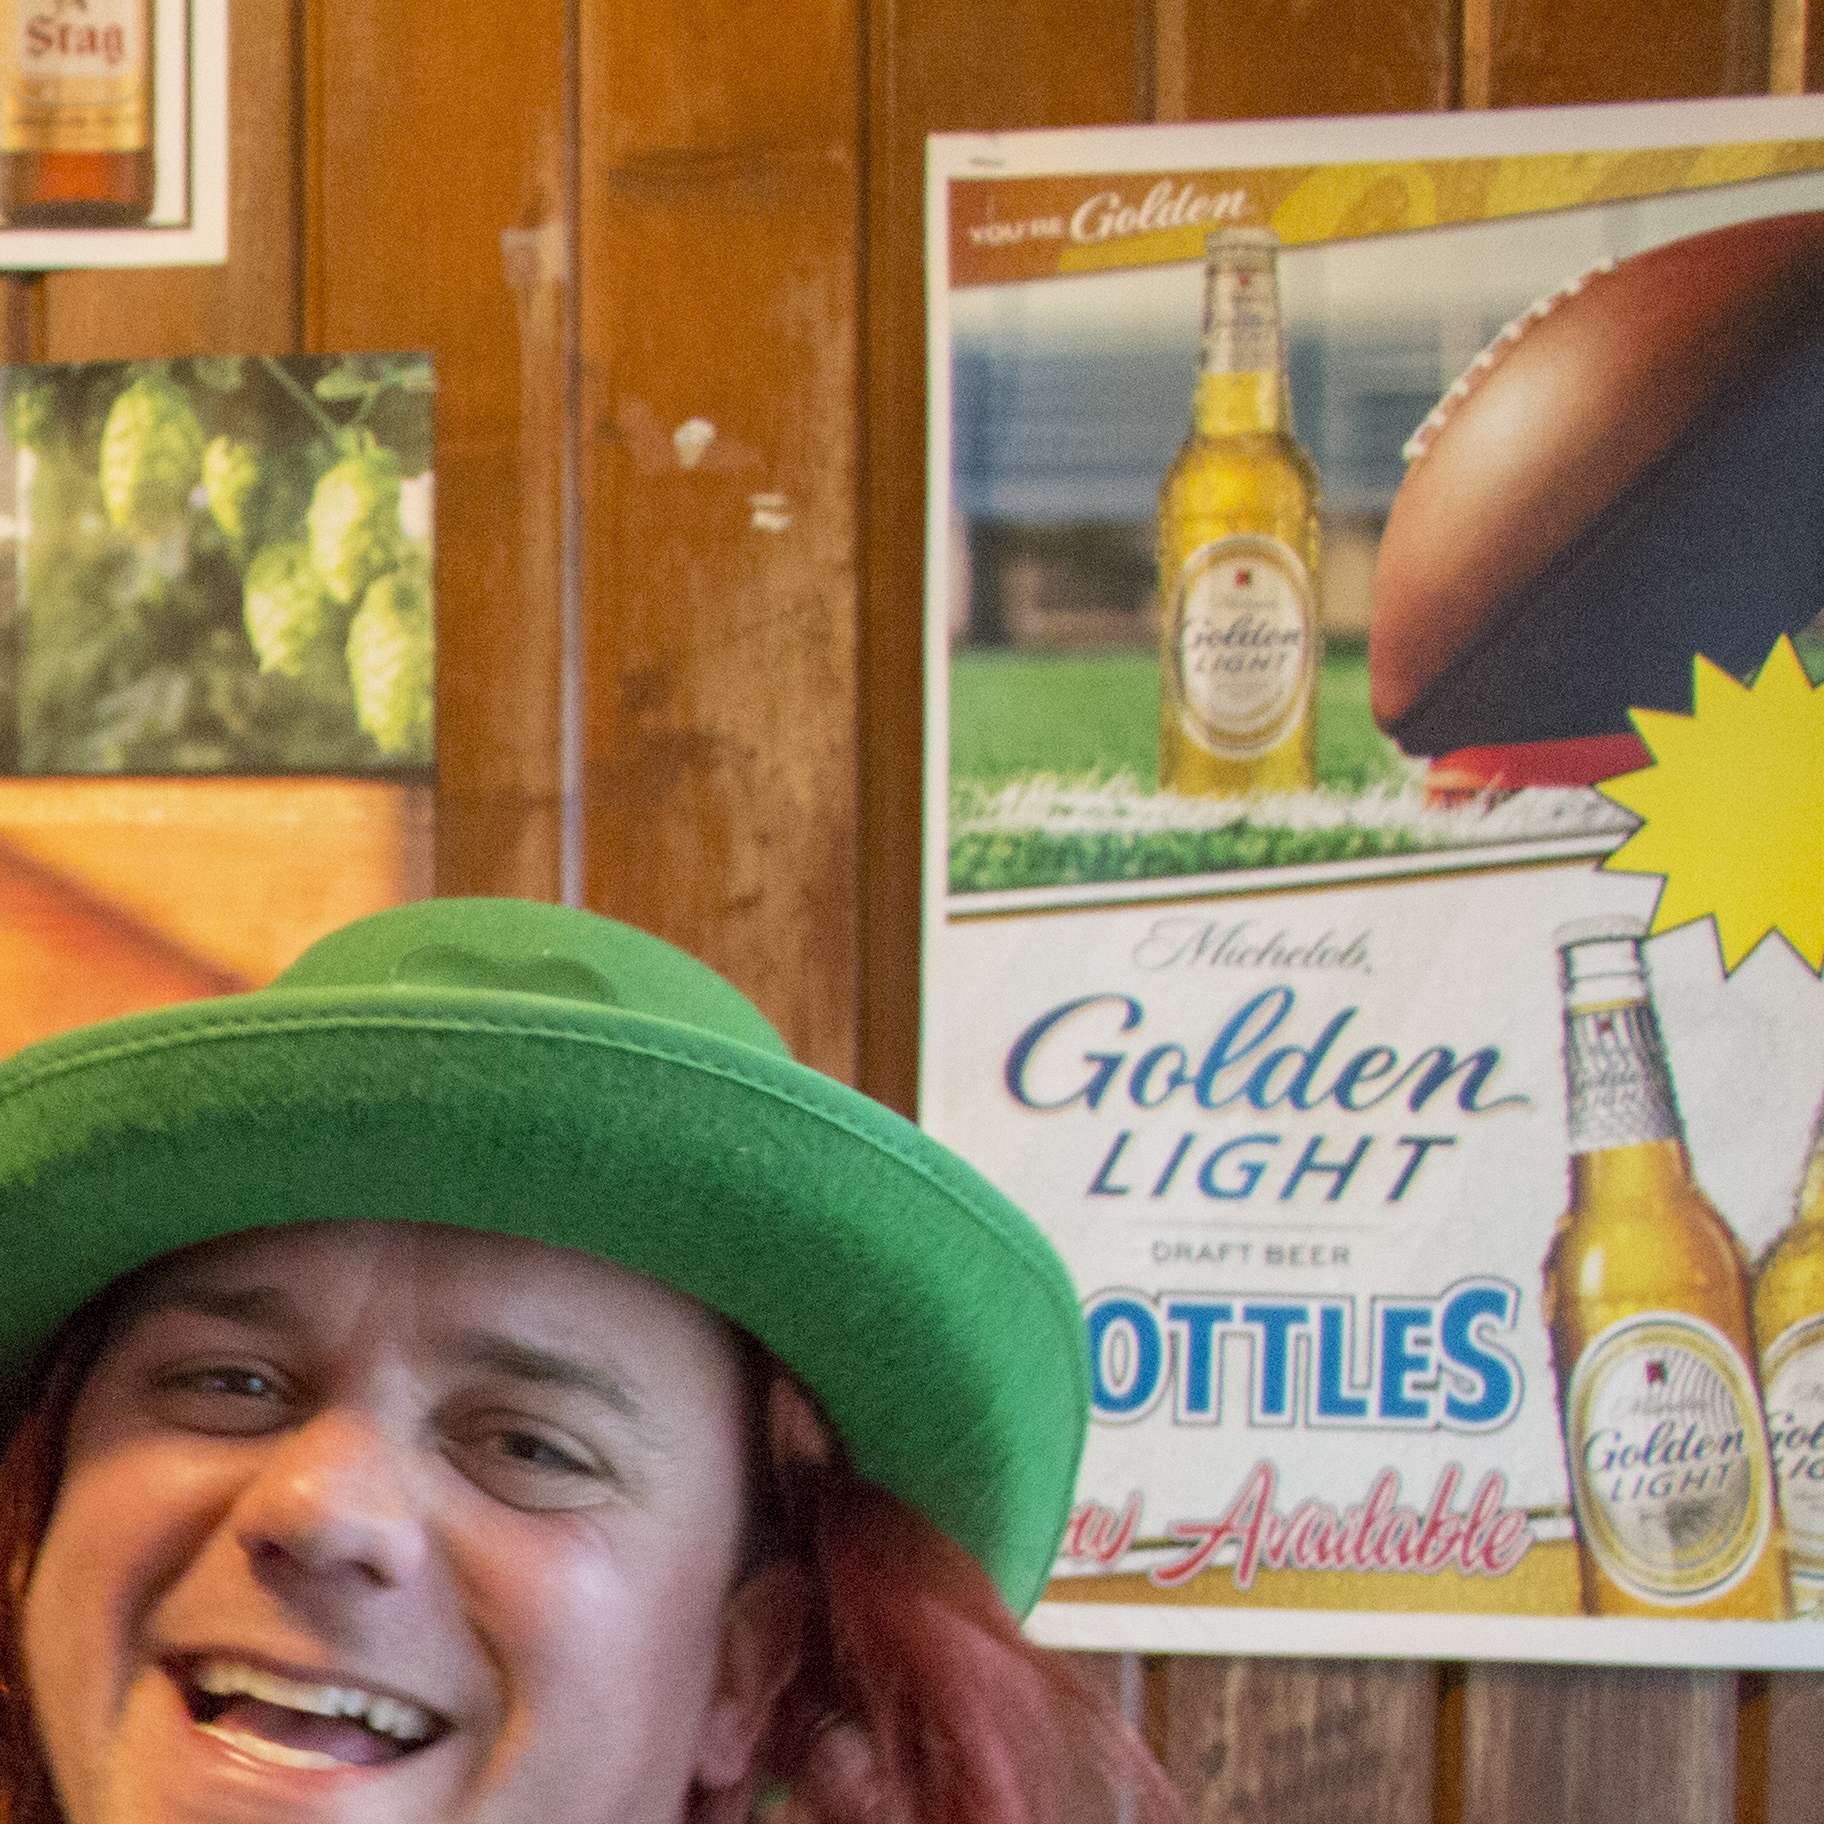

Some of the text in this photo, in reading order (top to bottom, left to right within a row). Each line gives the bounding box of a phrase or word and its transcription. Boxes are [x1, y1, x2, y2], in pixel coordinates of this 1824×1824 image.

[25, 15, 124, 67] Stag
[1069, 178, 1248, 245] Golden
[1002, 985, 1534, 1114] Golden
[1087, 1131, 1460, 1202] LIGHT
[1152, 1240, 1351, 1268] DRAFT BEER
[1083, 1278, 1524, 1435] OTTLES
[1585, 1421, 1745, 1472] Golden
[1610, 1463, 1730, 1502] LIGHT
[1155, 1462, 1534, 1588] Available
